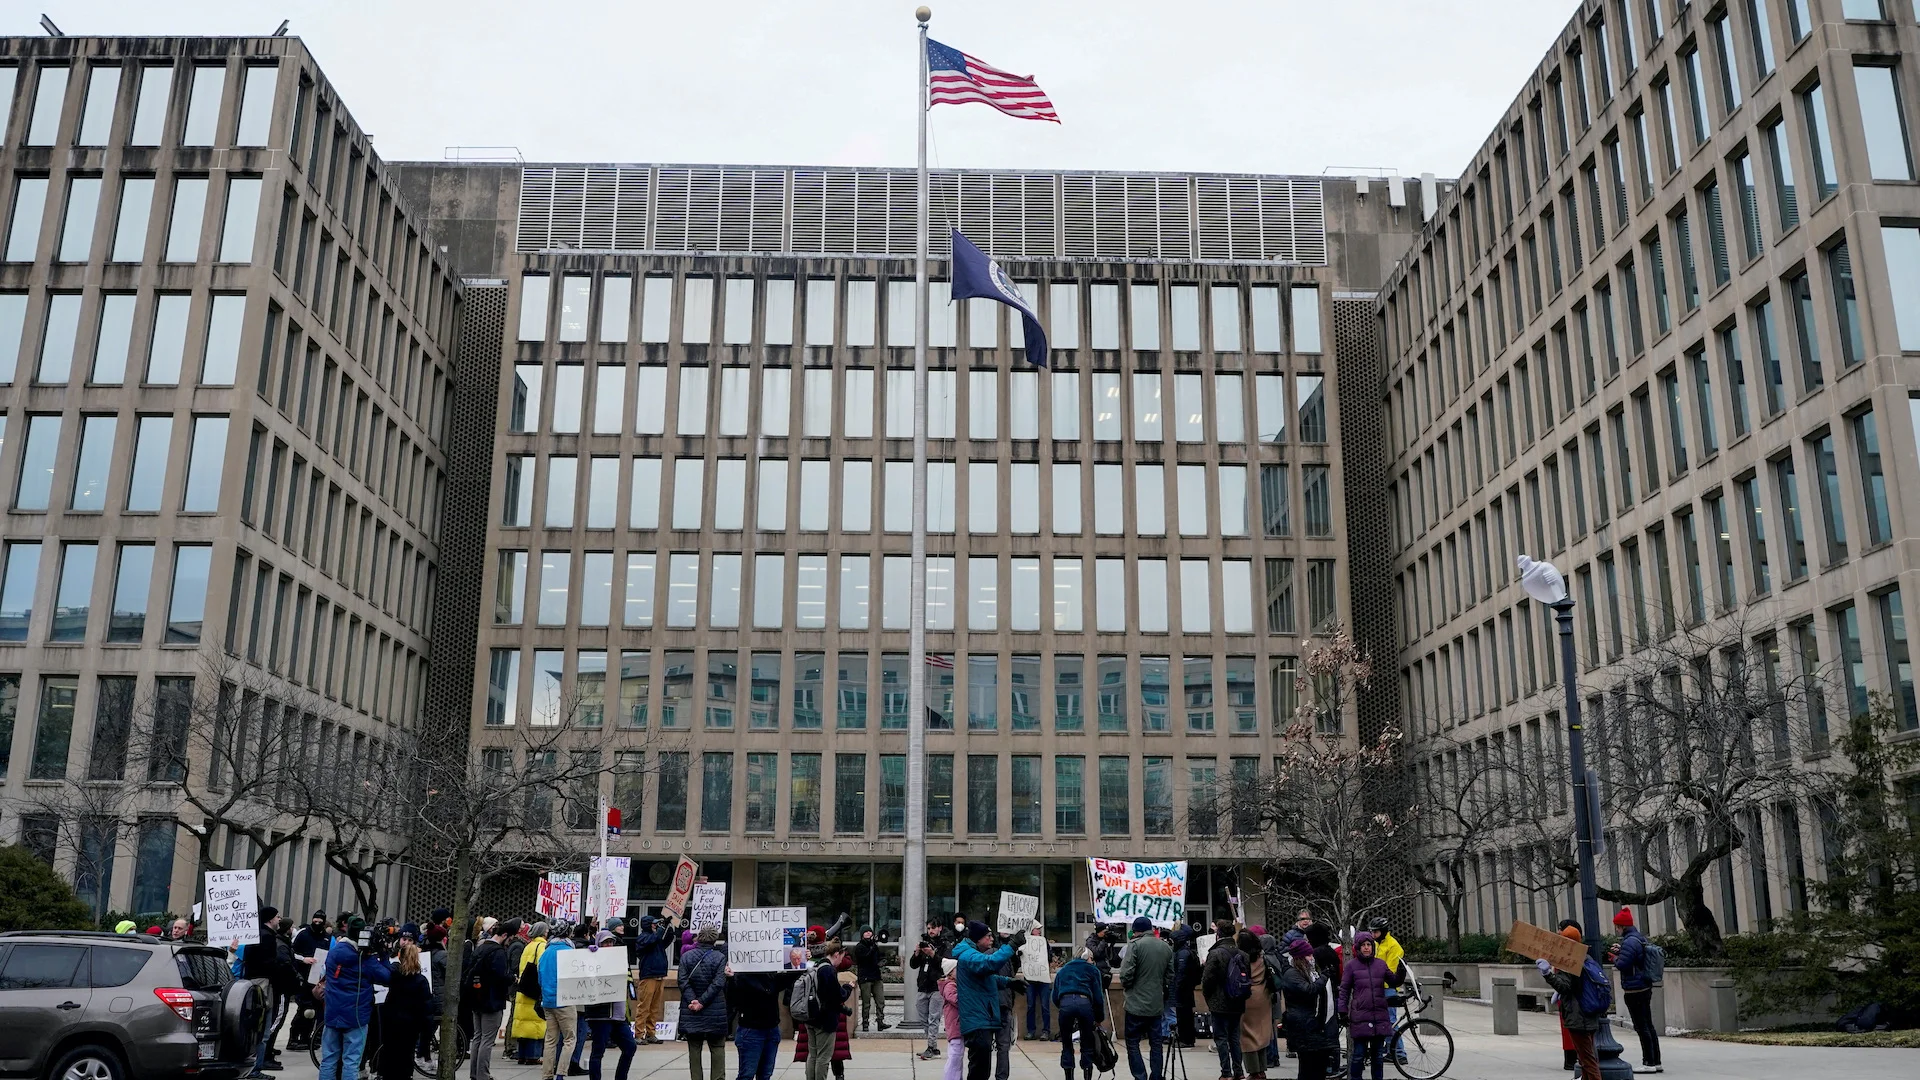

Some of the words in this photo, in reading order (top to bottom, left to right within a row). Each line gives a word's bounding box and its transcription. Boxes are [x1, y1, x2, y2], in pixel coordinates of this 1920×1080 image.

[948, 841, 1079, 853] FEDERAL
[615, 858, 630, 869] THE
[212, 874, 230, 882] GET
[550, 873, 579, 882] FEDERAL
[700, 895, 715, 903] Fed
[208, 902, 229, 913] HANDS
[232, 899, 247, 911] OFF
[696, 912, 718, 920] STAY
[729, 909, 801, 923] ENEMIES
[227, 920, 250, 929] DATA
[692, 920, 721, 931] STRONG
[729, 929, 771, 942] FOREIGN
[772, 927, 782, 941] &
[729, 949, 782, 964] DOMESTIC
[576, 978, 612, 990] MUSK
